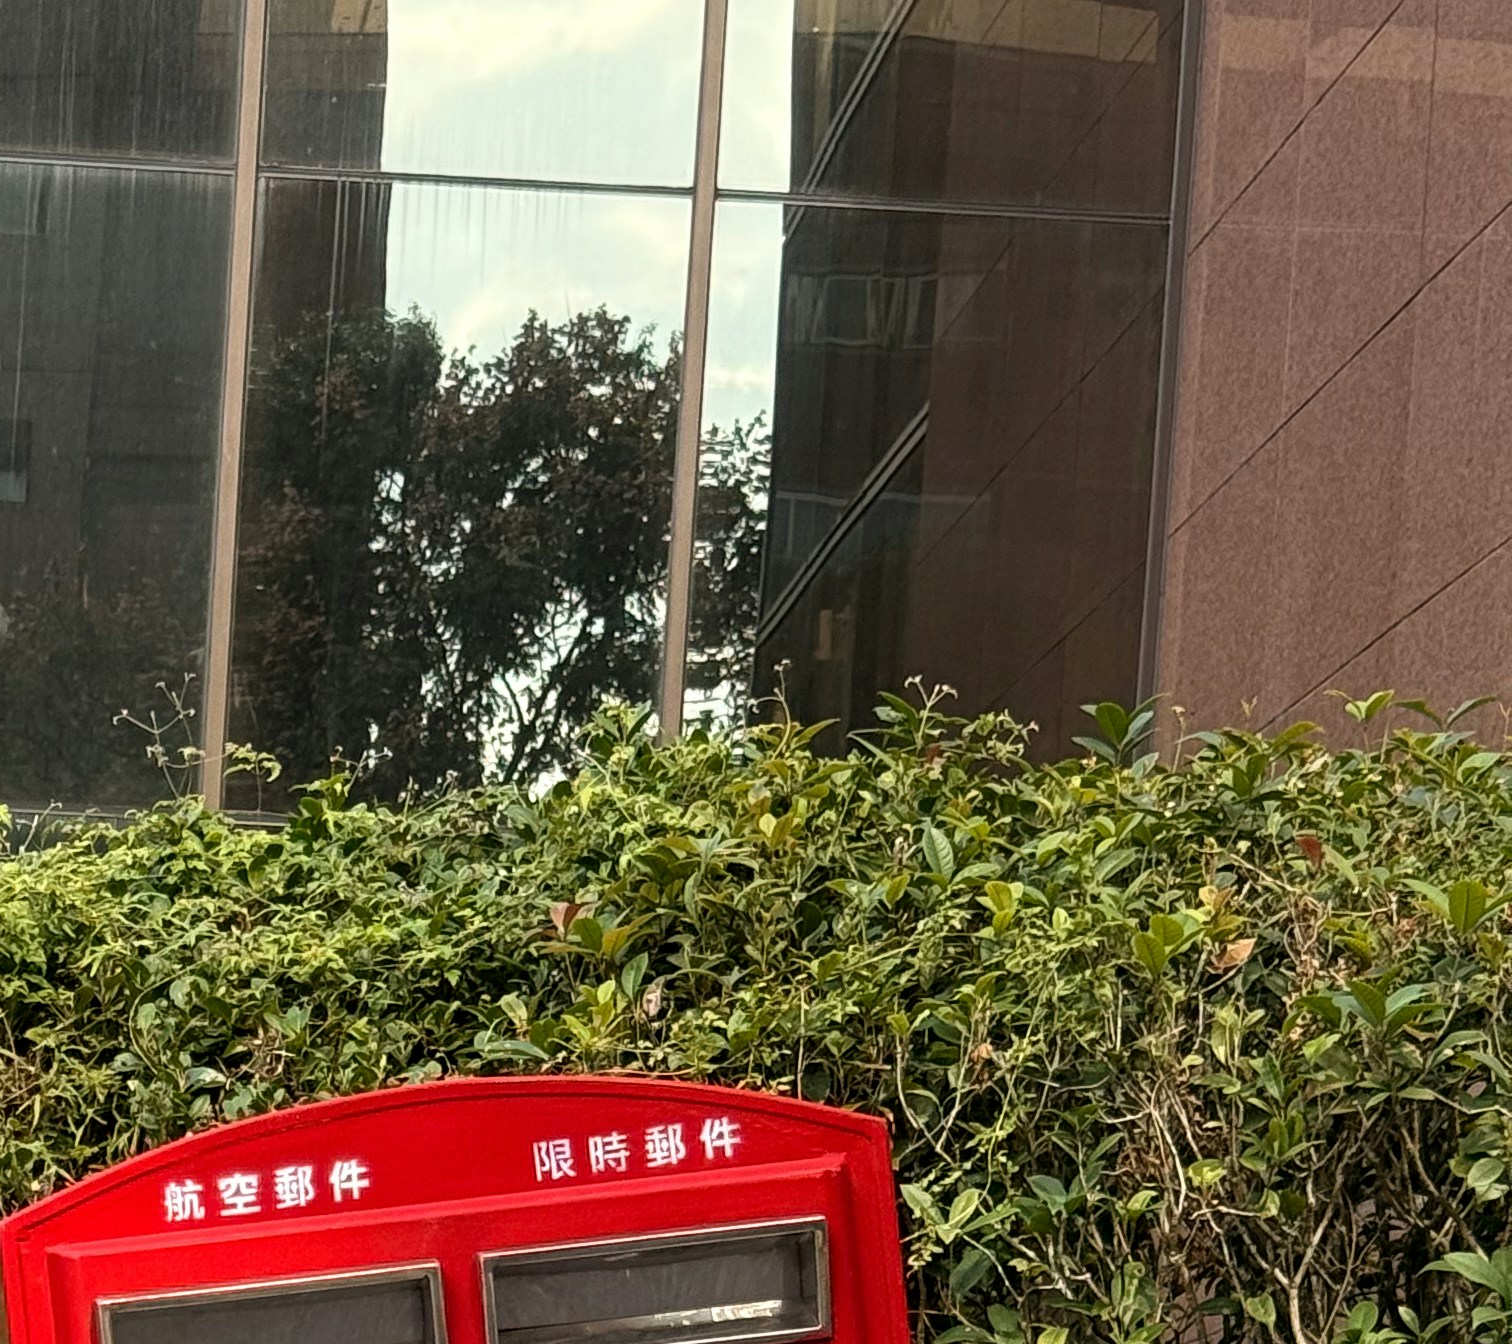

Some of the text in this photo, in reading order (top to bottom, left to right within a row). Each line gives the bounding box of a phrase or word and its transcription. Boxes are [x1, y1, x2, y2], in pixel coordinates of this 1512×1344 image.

[533, 1116, 741, 1182] 限時郵件
[163, 1158, 370, 1222] 航空郵件
